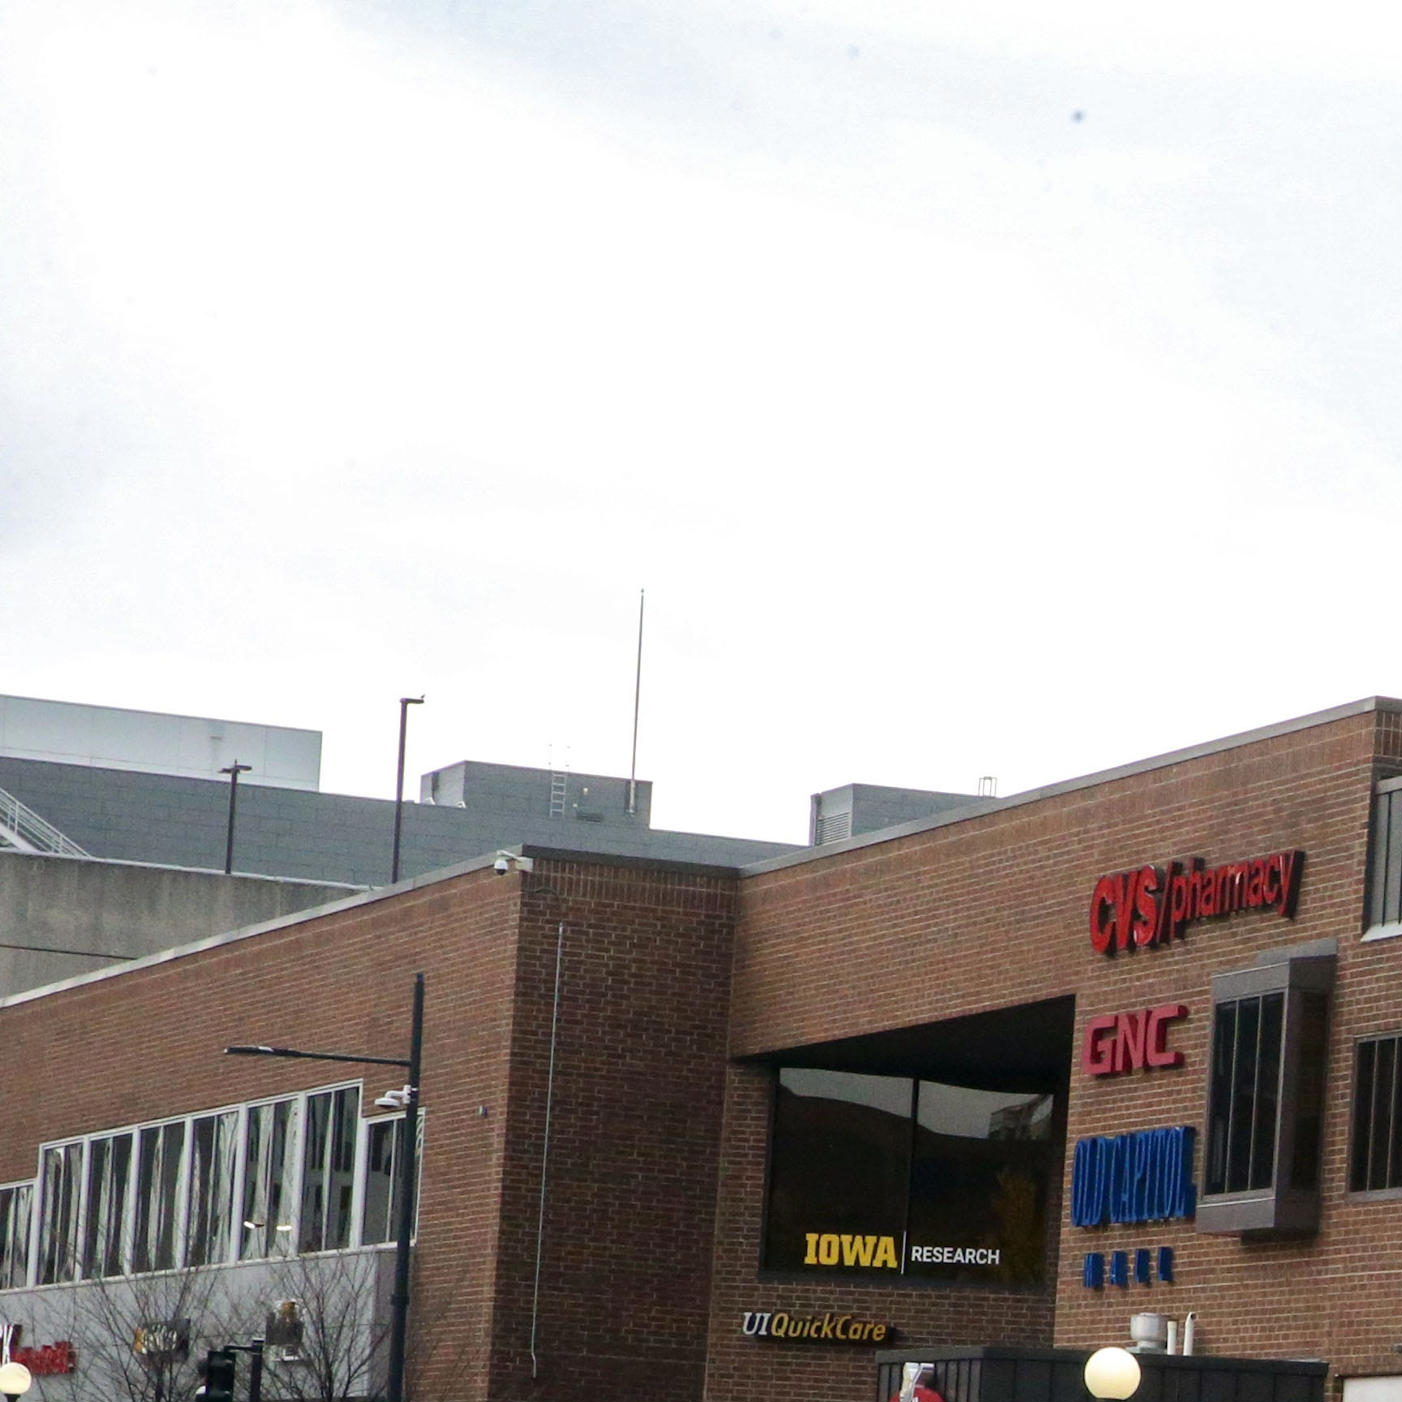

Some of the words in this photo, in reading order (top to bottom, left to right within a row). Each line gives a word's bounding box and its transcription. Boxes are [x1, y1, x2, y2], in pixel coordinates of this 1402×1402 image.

[1090, 850, 1300, 954] CVS/pharmacy
[1083, 1004, 1187, 1075] GNC
[804, 1233, 898, 1268] IOWA
[911, 1246, 1000, 1265] RESEARCH
